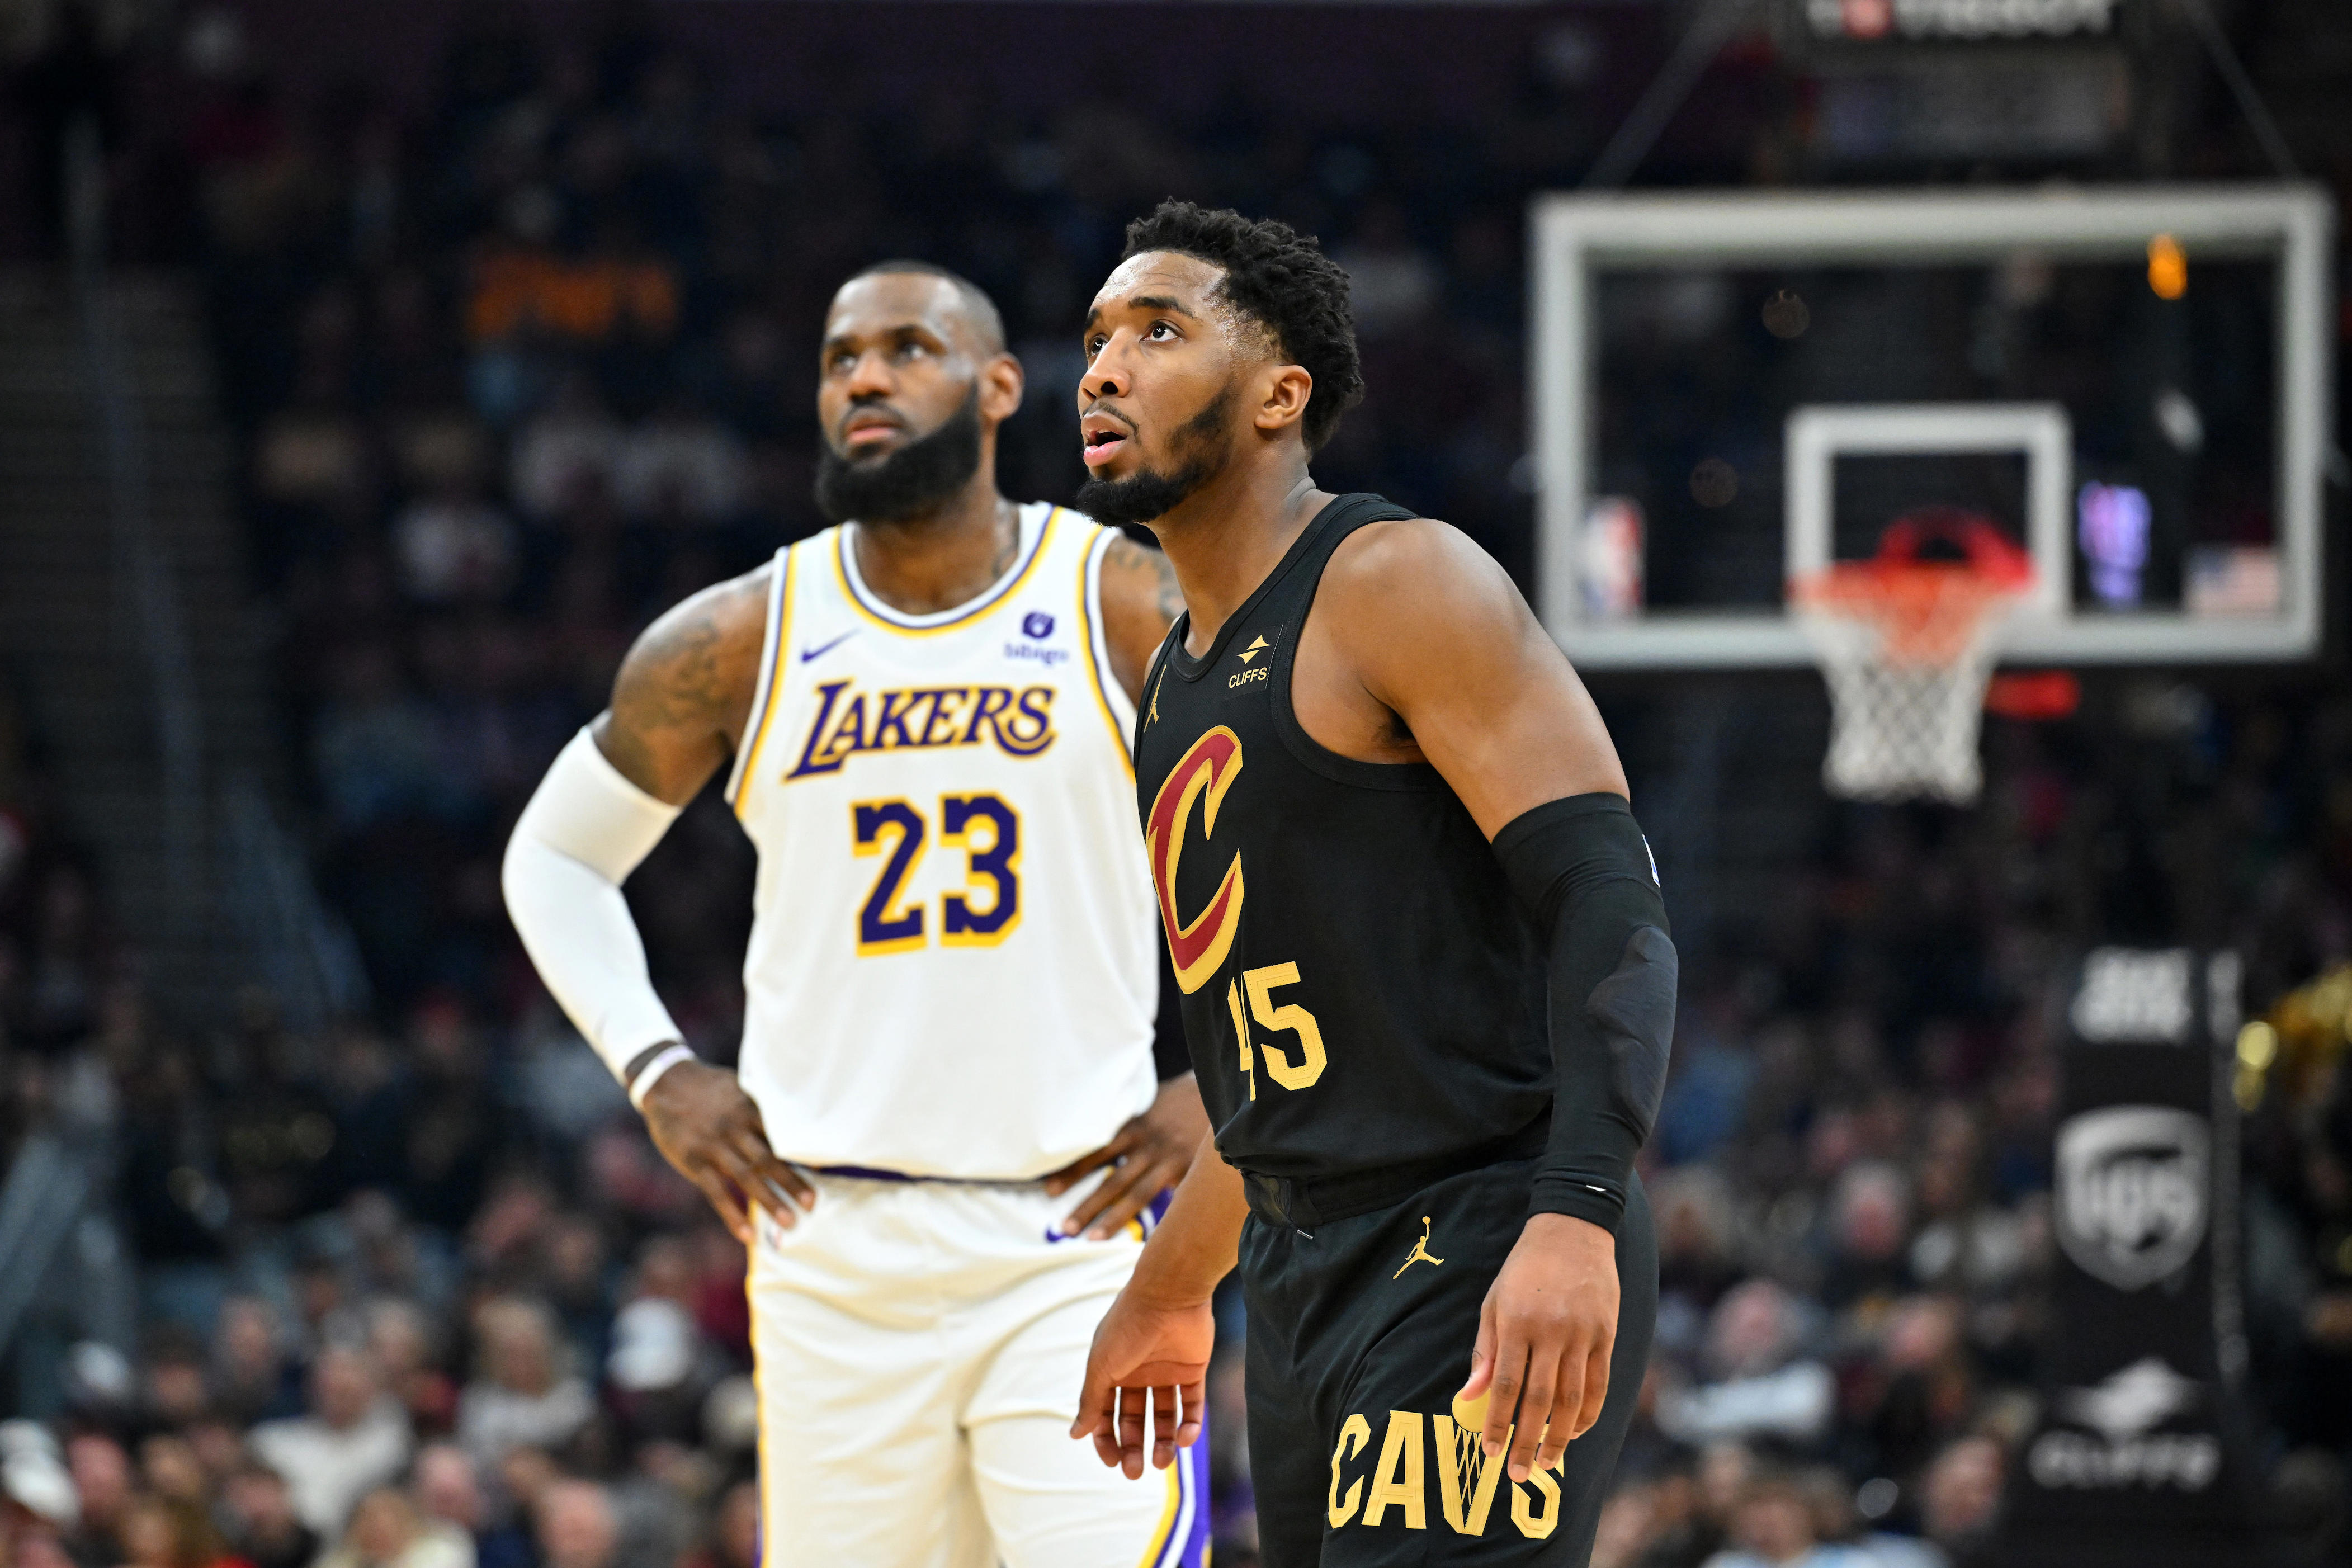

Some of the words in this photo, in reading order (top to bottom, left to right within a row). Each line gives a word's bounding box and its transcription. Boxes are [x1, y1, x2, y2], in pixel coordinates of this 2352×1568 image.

[1229, 667, 1268, 688] CLIFFS
[849, 791, 1022, 958] 23
[1146, 725, 1245, 994] C
[1227, 961, 1328, 1102] 45
[1328, 1410, 1565, 1539] CAVS
